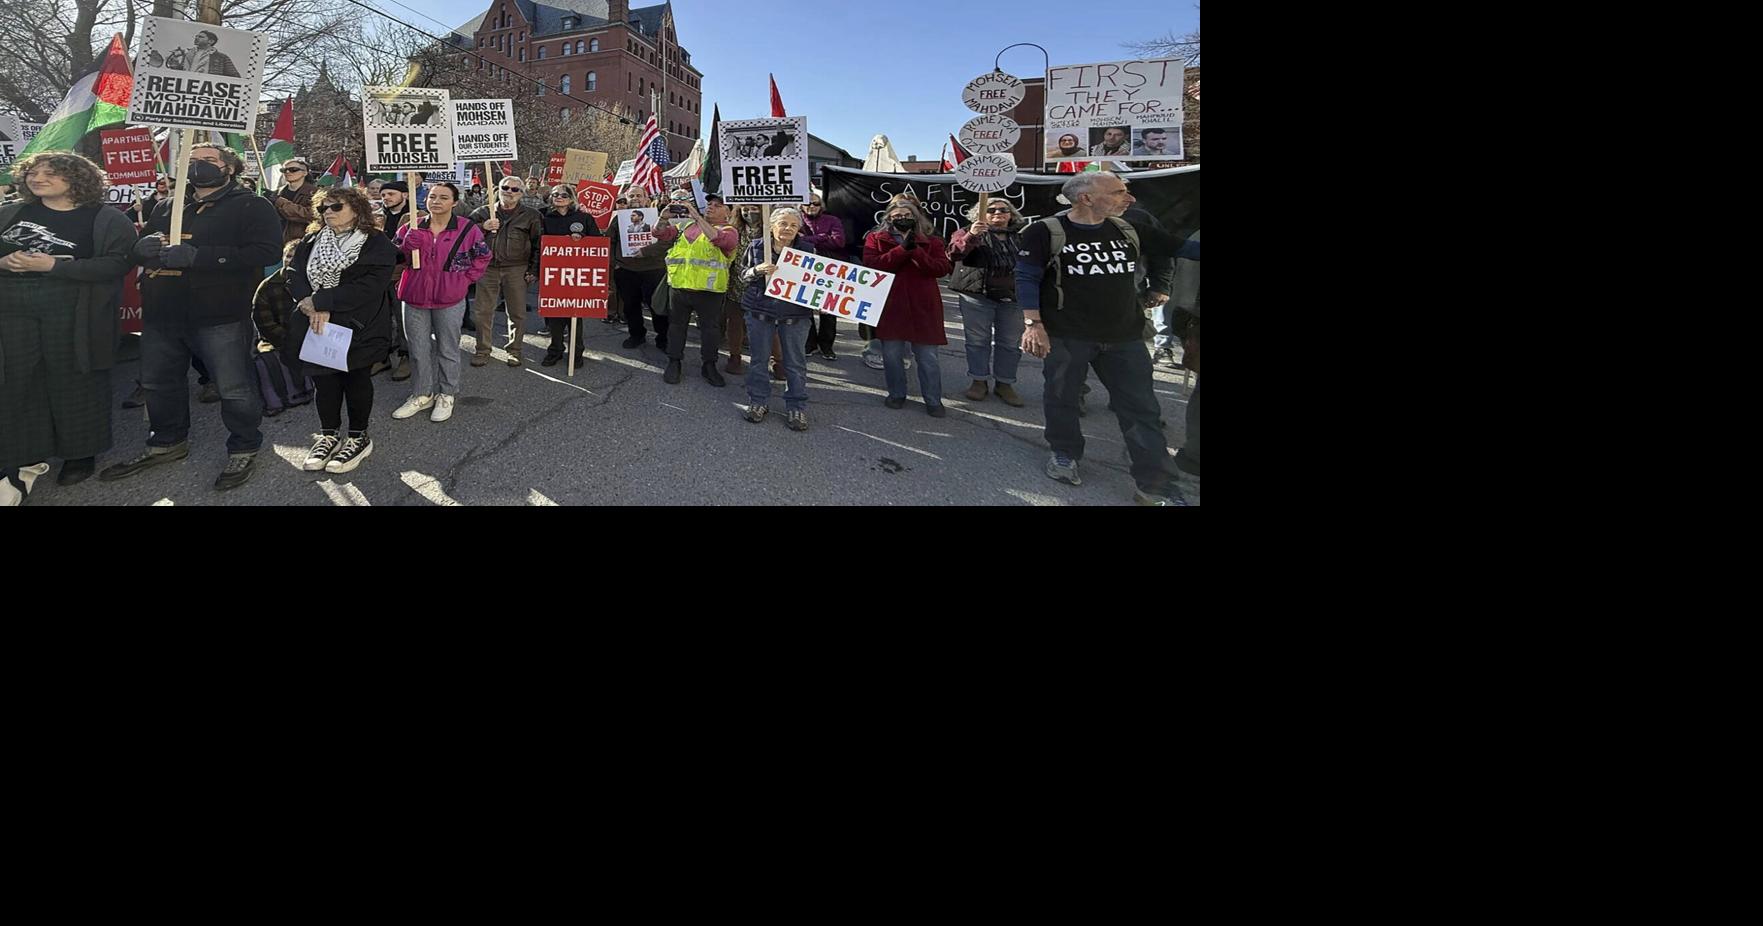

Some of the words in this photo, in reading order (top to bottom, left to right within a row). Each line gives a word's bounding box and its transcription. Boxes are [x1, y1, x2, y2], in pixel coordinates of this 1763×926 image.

[1049, 58, 1182, 90] FIRST
[146, 75, 242, 99] RELEASE
[966, 71, 1022, 92] MOHSEN
[145, 92, 240, 107] MOHSEN
[980, 88, 1007, 99] FREE
[1065, 88, 1141, 104] THEY
[142, 100, 239, 120] MAHDAWI
[455, 102, 488, 111] HANDS
[489, 102, 505, 110] OFF
[964, 95, 1020, 114] MAHDAWI
[1049, 103, 1108, 120] CAME
[456, 110, 506, 121] MOHSEN
[962, 114, 1018, 134] RUMEYSA
[102, 134, 150, 145] APARTHEID
[376, 133, 439, 152] FREE
[458, 133, 491, 143] HANDS
[492, 133, 509, 142] OFF
[960, 137, 1012, 154] OZTURK
[106, 149, 153, 165] FREE
[378, 152, 439, 164] MOHSEN
[108, 169, 156, 180] COMMUNITY
[427, 171, 457, 180] MOHSEN
[731, 165, 792, 186] FREE
[733, 184, 793, 196] MOHSEN
[962, 179, 1006, 192] KHALIL
[583, 190, 610, 203] STOP
[870, 182, 1025, 212] SAFEY
[587, 200, 603, 210] ICE
[627, 233, 652, 242] FREE
[542, 246, 609, 257] APARTHEID
[1062, 241, 1102, 254] NOT
[1076, 250, 1127, 264] OUR
[783, 250, 887, 288] DEMOCRACY
[1067, 261, 1136, 275] NAME
[544, 267, 607, 287] FREE
[838, 281, 855, 294] in
[540, 297, 609, 309] COMMUNITY
[768, 277, 872, 321] SILENCE
